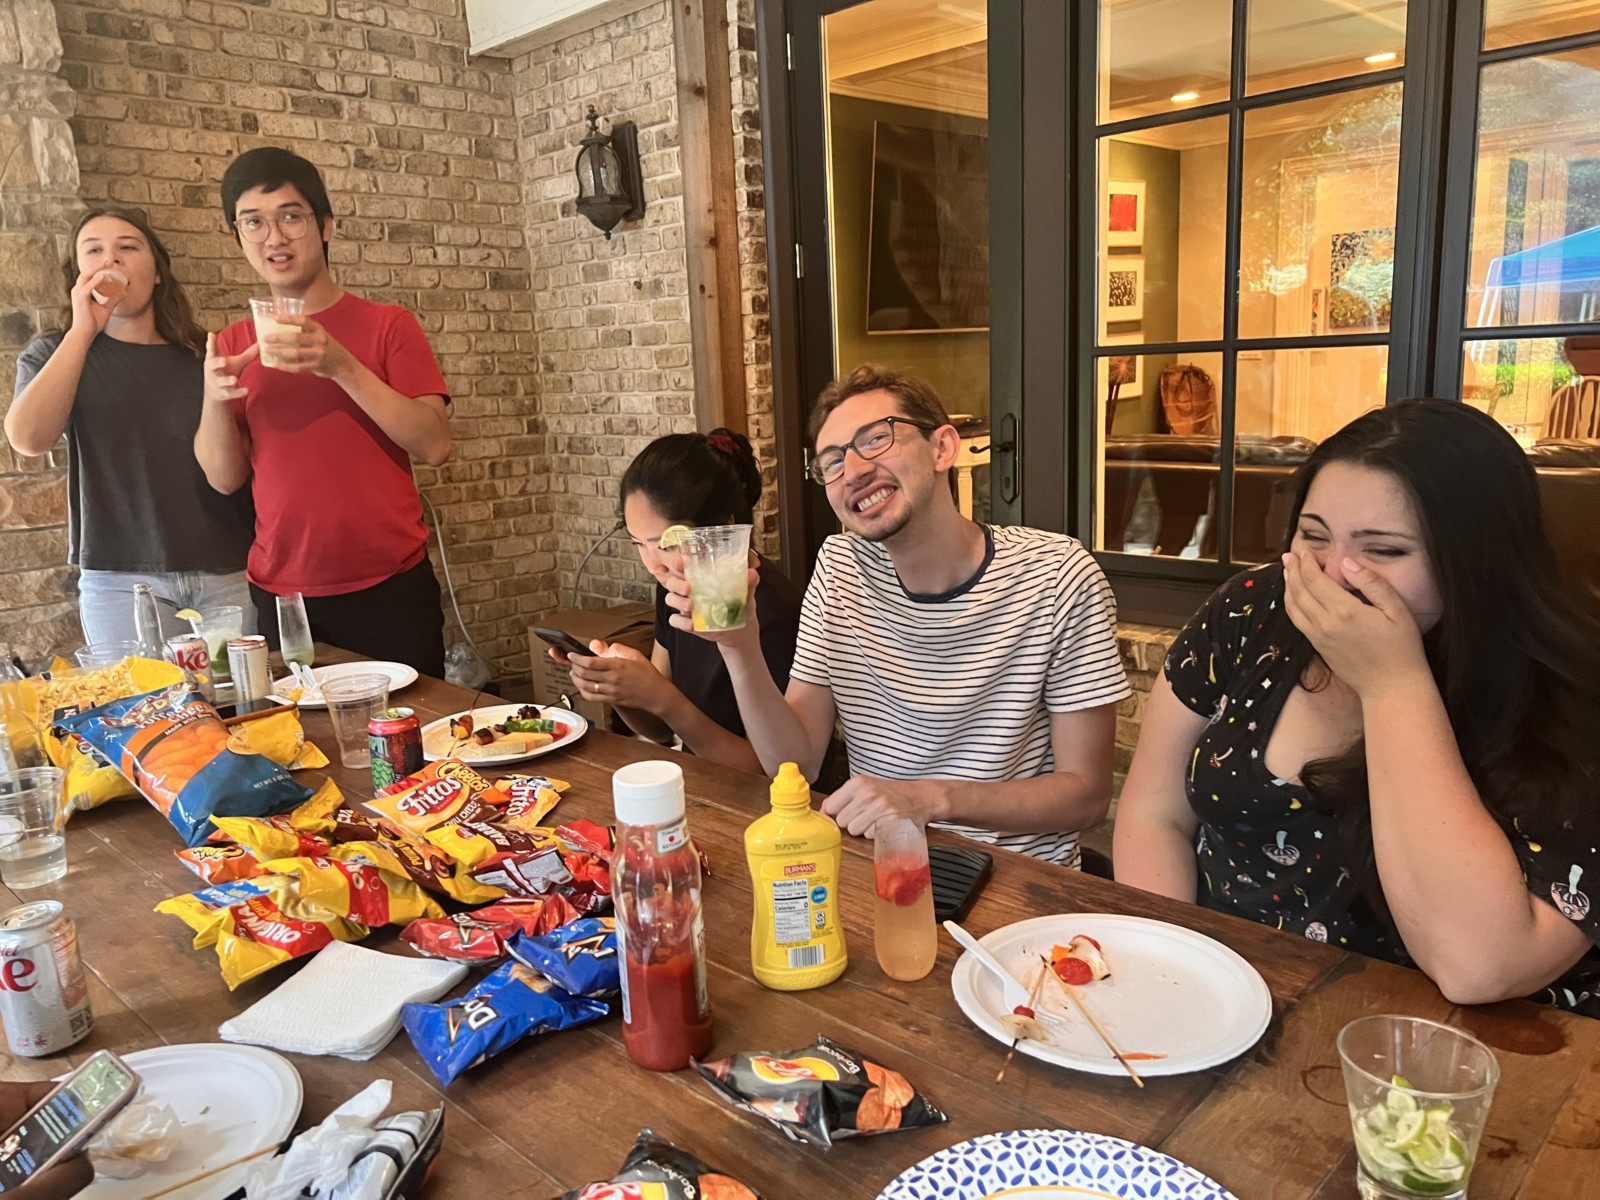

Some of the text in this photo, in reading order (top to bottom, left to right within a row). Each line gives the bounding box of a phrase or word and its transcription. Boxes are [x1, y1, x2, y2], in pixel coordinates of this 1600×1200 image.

[176, 648, 209, 672] ke
[168, 703, 207, 723] Chee
[435, 762, 490, 792] Cheetos
[397, 775, 463, 818] Fritos
[250, 899, 270, 917] CHIP
